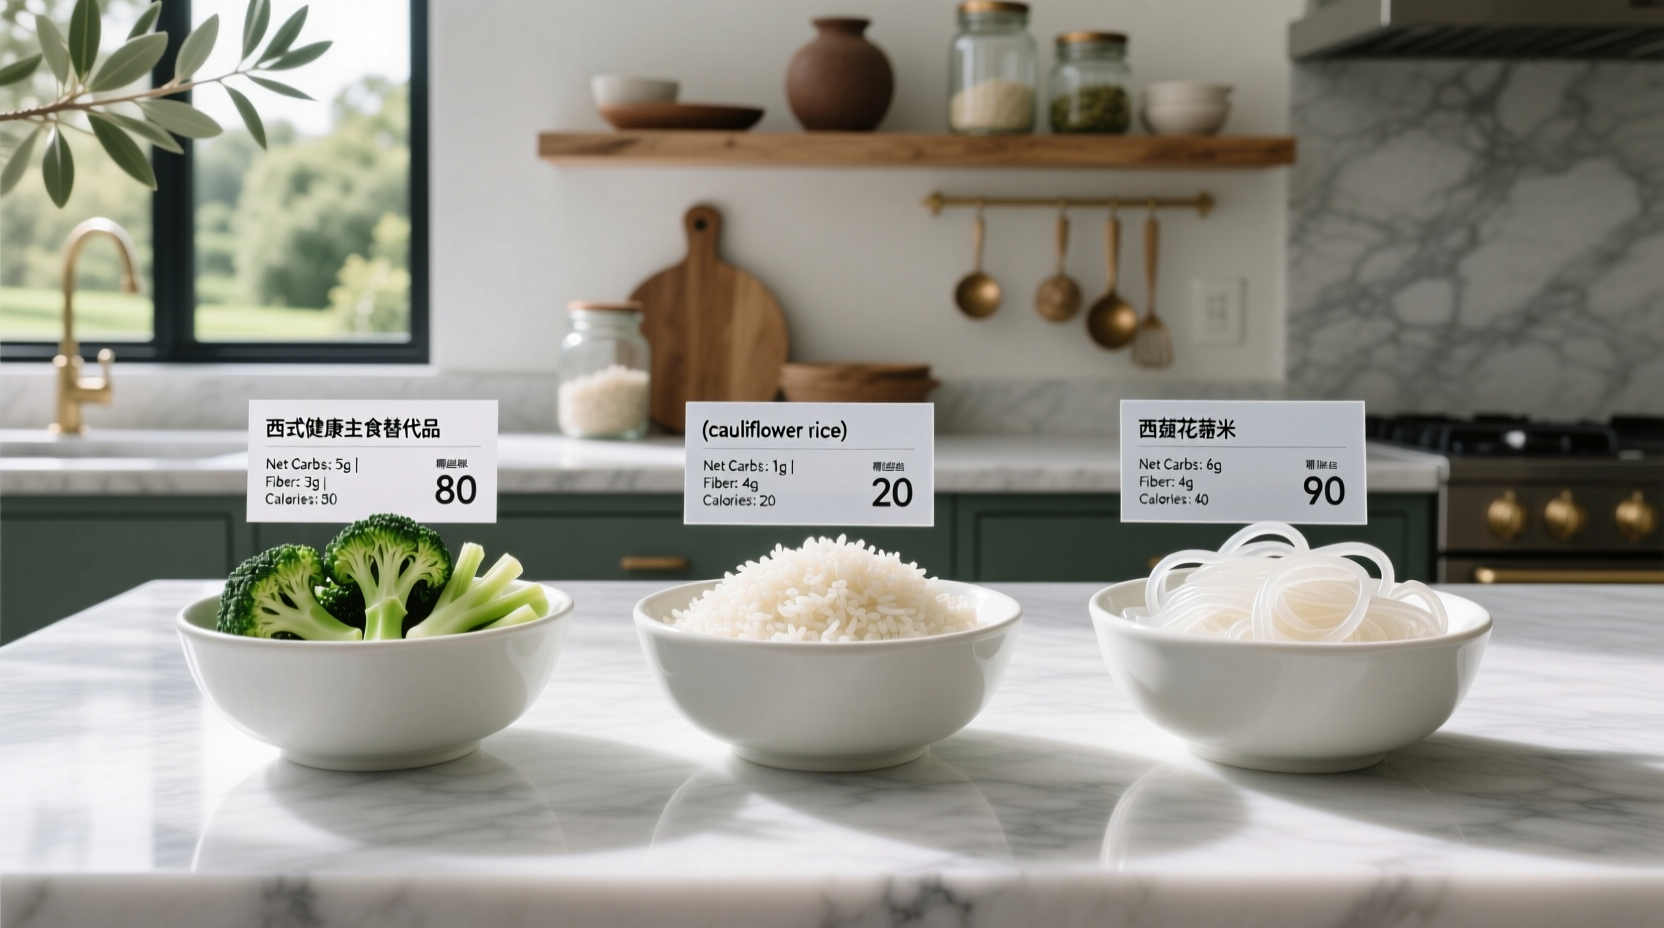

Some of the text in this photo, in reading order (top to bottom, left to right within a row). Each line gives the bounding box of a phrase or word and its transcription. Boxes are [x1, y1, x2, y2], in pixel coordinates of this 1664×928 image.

[265, 416, 441, 439] 西式健康主食替代品
[703, 420, 848, 442] (cauliflower rice)
[266, 458, 289, 470] Net
[335, 458, 351, 474] 5g
[703, 460, 726, 471] Net
[728, 459, 769, 472] Carbs:
[773, 459, 787, 476] 1g
[1139, 457, 1222, 474] Net Carbs: 6g
[265, 475, 301, 488] Fiber:
[304, 476, 320, 491] 3g
[435, 474, 477, 505] 80
[703, 477, 759, 492] Fiber: 4g
[1139, 475, 1194, 491] Fiber: 4g
[1303, 476, 1346, 506] 90
[265, 493, 318, 505] Calories:
[872, 477, 914, 507] 20
[1139, 493, 1209, 506] Calories: 40
[703, 494, 776, 507] Calories: 20
